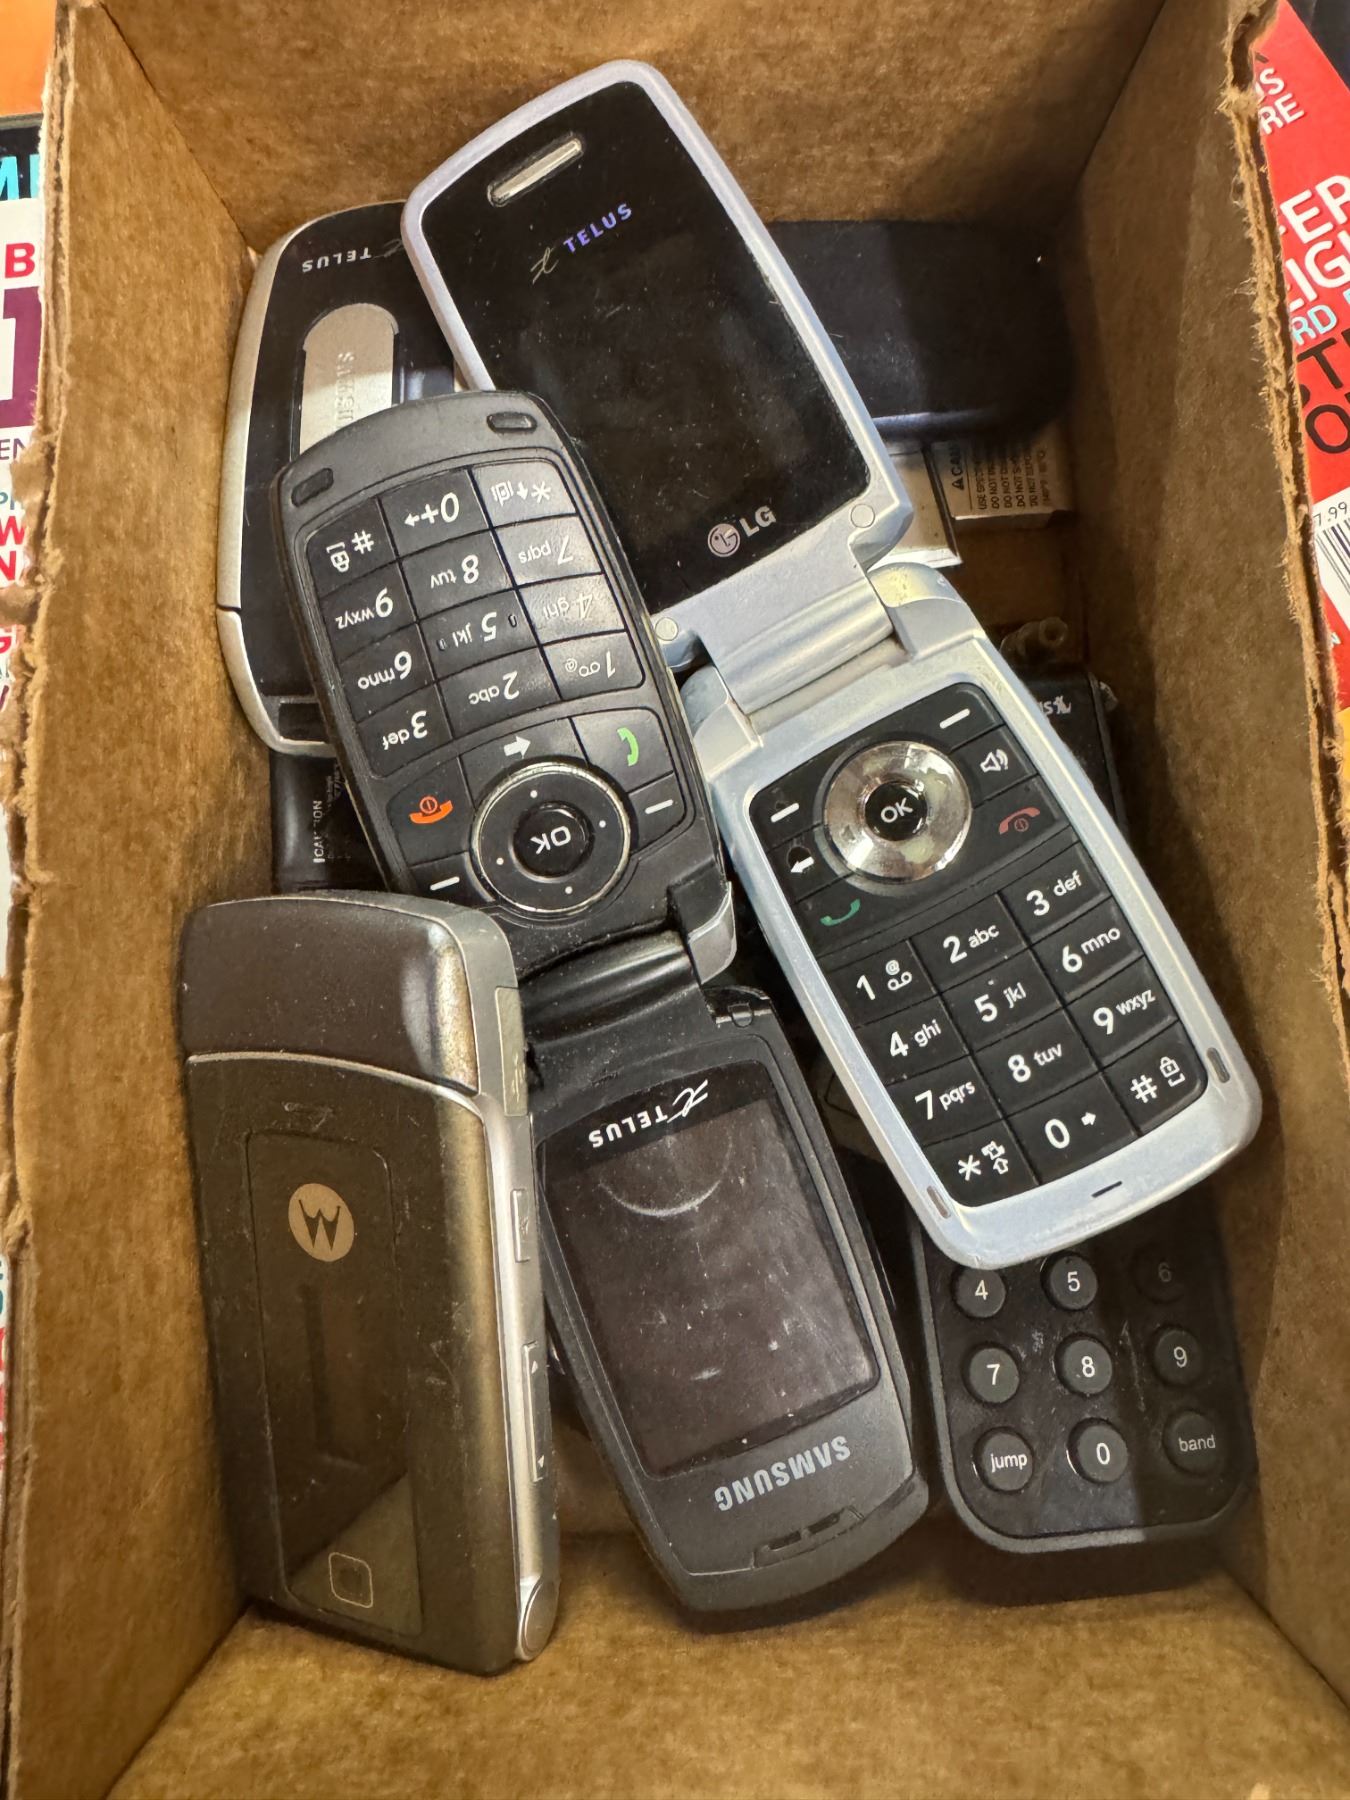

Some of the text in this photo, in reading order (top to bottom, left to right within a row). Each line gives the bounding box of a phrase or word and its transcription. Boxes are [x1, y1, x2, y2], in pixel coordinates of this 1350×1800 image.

[1279, 175, 1350, 244] EP
[563, 203, 632, 253] TELUS
[302, 247, 372, 273] TELUS
[1286, 232, 1350, 312] IG
[1305, 402, 1350, 454] O
[988, 477, 998, 495] NOT
[1000, 476, 1010, 494] NOT
[1003, 495, 1012, 508] DO
[1015, 494, 1025, 507] DO
[990, 496, 1000, 509] DO
[739, 505, 777, 537] LG
[518, 535, 574, 565] 7 pqrs
[430, 554, 480, 589] 8 tuv
[335, 587, 393, 629] 9 wxyz
[452, 611, 498, 647] 5 jkl
[357, 650, 412, 689] 6 mno
[468, 671, 520, 705] 2 abc
[382, 710, 428, 751] 3 def
[880, 797, 914, 824] OK
[313, 800, 325, 857] CAON
[530, 825, 572, 855] OK
[1026, 869, 1083, 916] 3 def
[942, 924, 1000, 964] 2 abc
[1062, 927, 1121, 973] 6 mno
[856, 974, 876, 1001] 1
[974, 982, 1027, 1022] 5 jkl
[1093, 989, 1156, 1035] 9 wxyz
[889, 1019, 942, 1057] 4 ghi
[1007, 1043, 1063, 1083] 8 tuv
[914, 1081, 976, 1120] 7 pqrs
[588, 1105, 668, 1149] TELUS
[1044, 1118, 1071, 1149] 0
[1066, 1271, 1081, 1292] 5
[1157, 1262, 1172, 1283] 6
[974, 1279, 989, 1300] 4
[1081, 1356, 1096, 1378] 8
[1173, 1346, 1188, 1368] 9
[986, 1363, 1001, 1385] 7
[1096, 1442, 1111, 1465] 0
[1178, 1434, 1216, 1452] band
[714, 1436, 851, 1511] SAMSUNG
[990, 1452, 1028, 1472] jump
